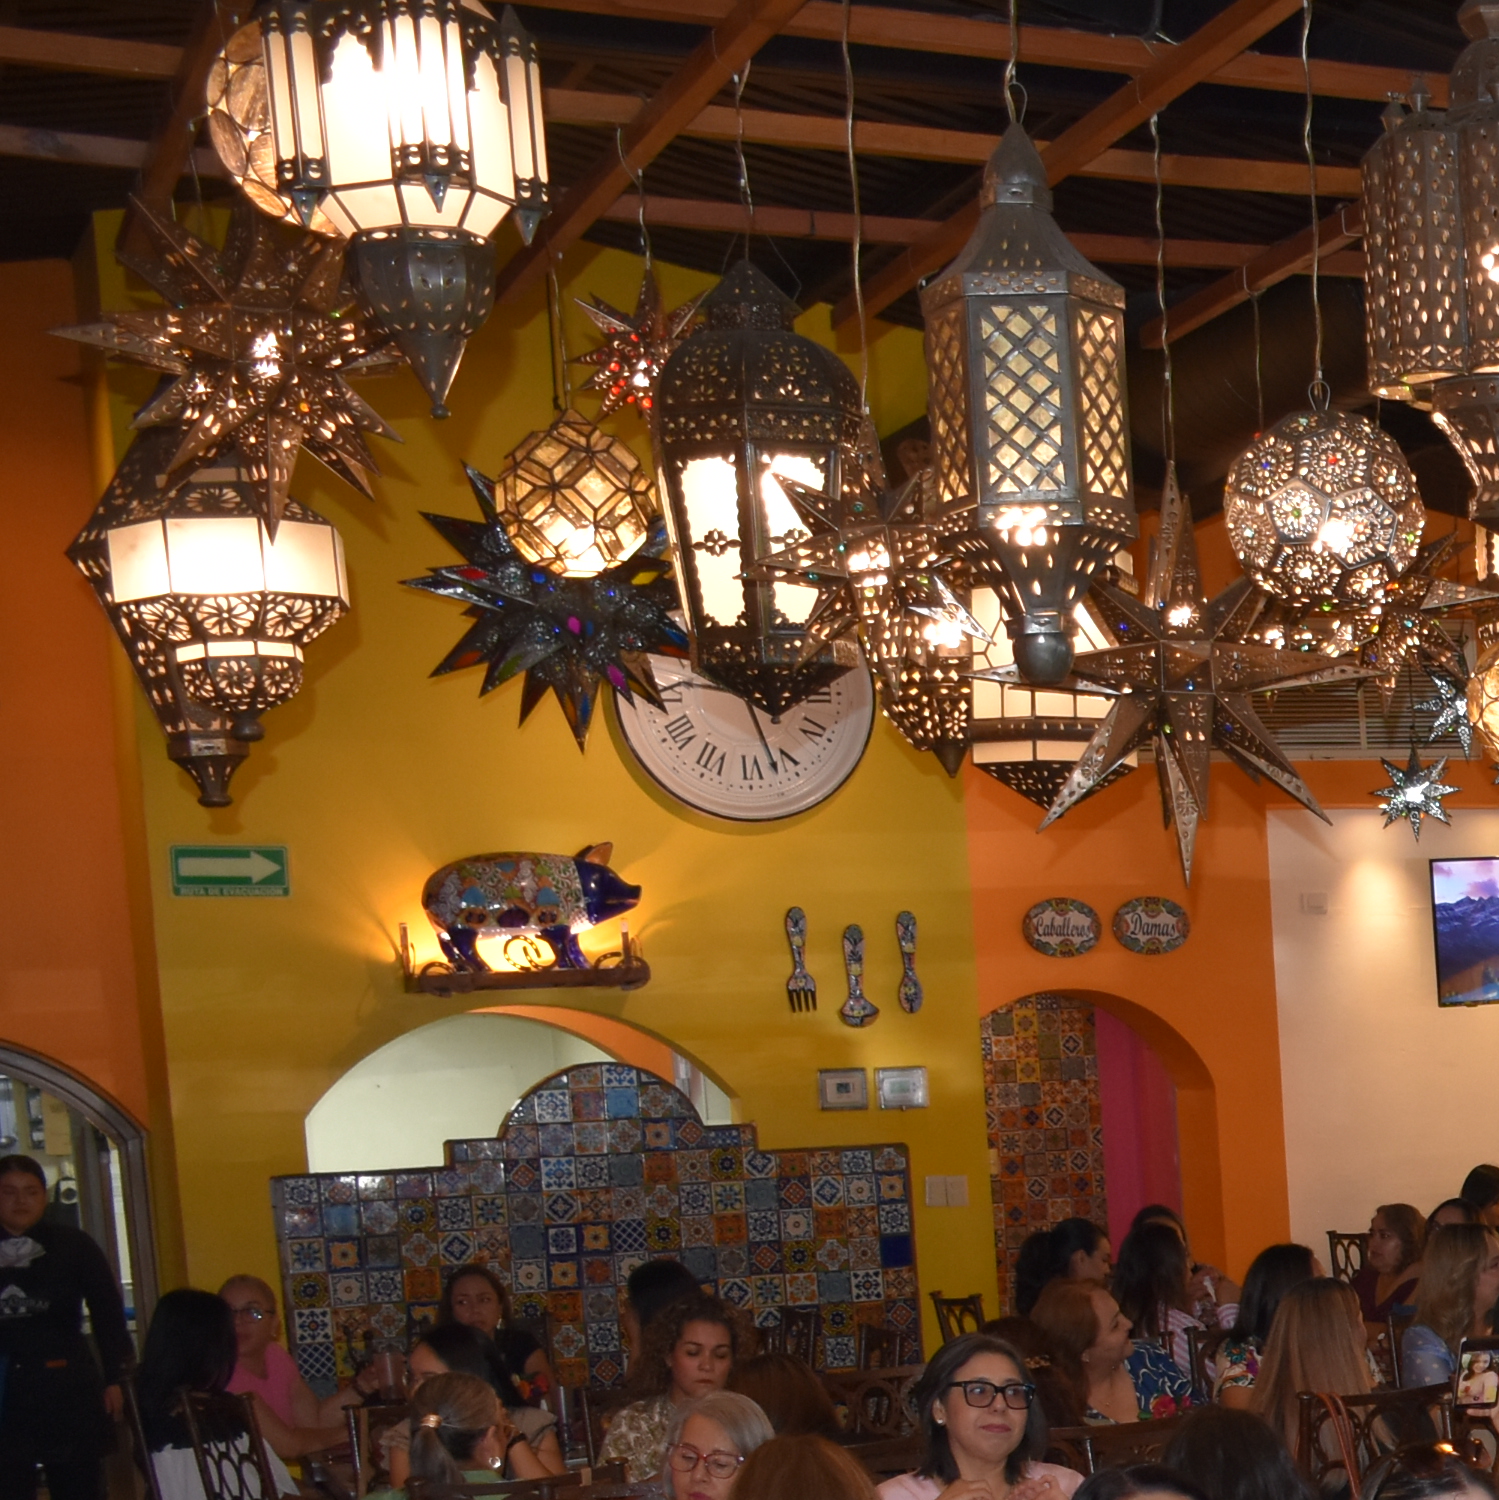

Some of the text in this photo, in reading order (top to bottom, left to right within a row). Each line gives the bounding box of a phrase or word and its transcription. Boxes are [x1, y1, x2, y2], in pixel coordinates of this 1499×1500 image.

[696, 741, 727, 776] VII
[741, 754, 764, 781] VI
[180, 887, 205, 895] RUTA
[207, 887, 220, 895] DE
